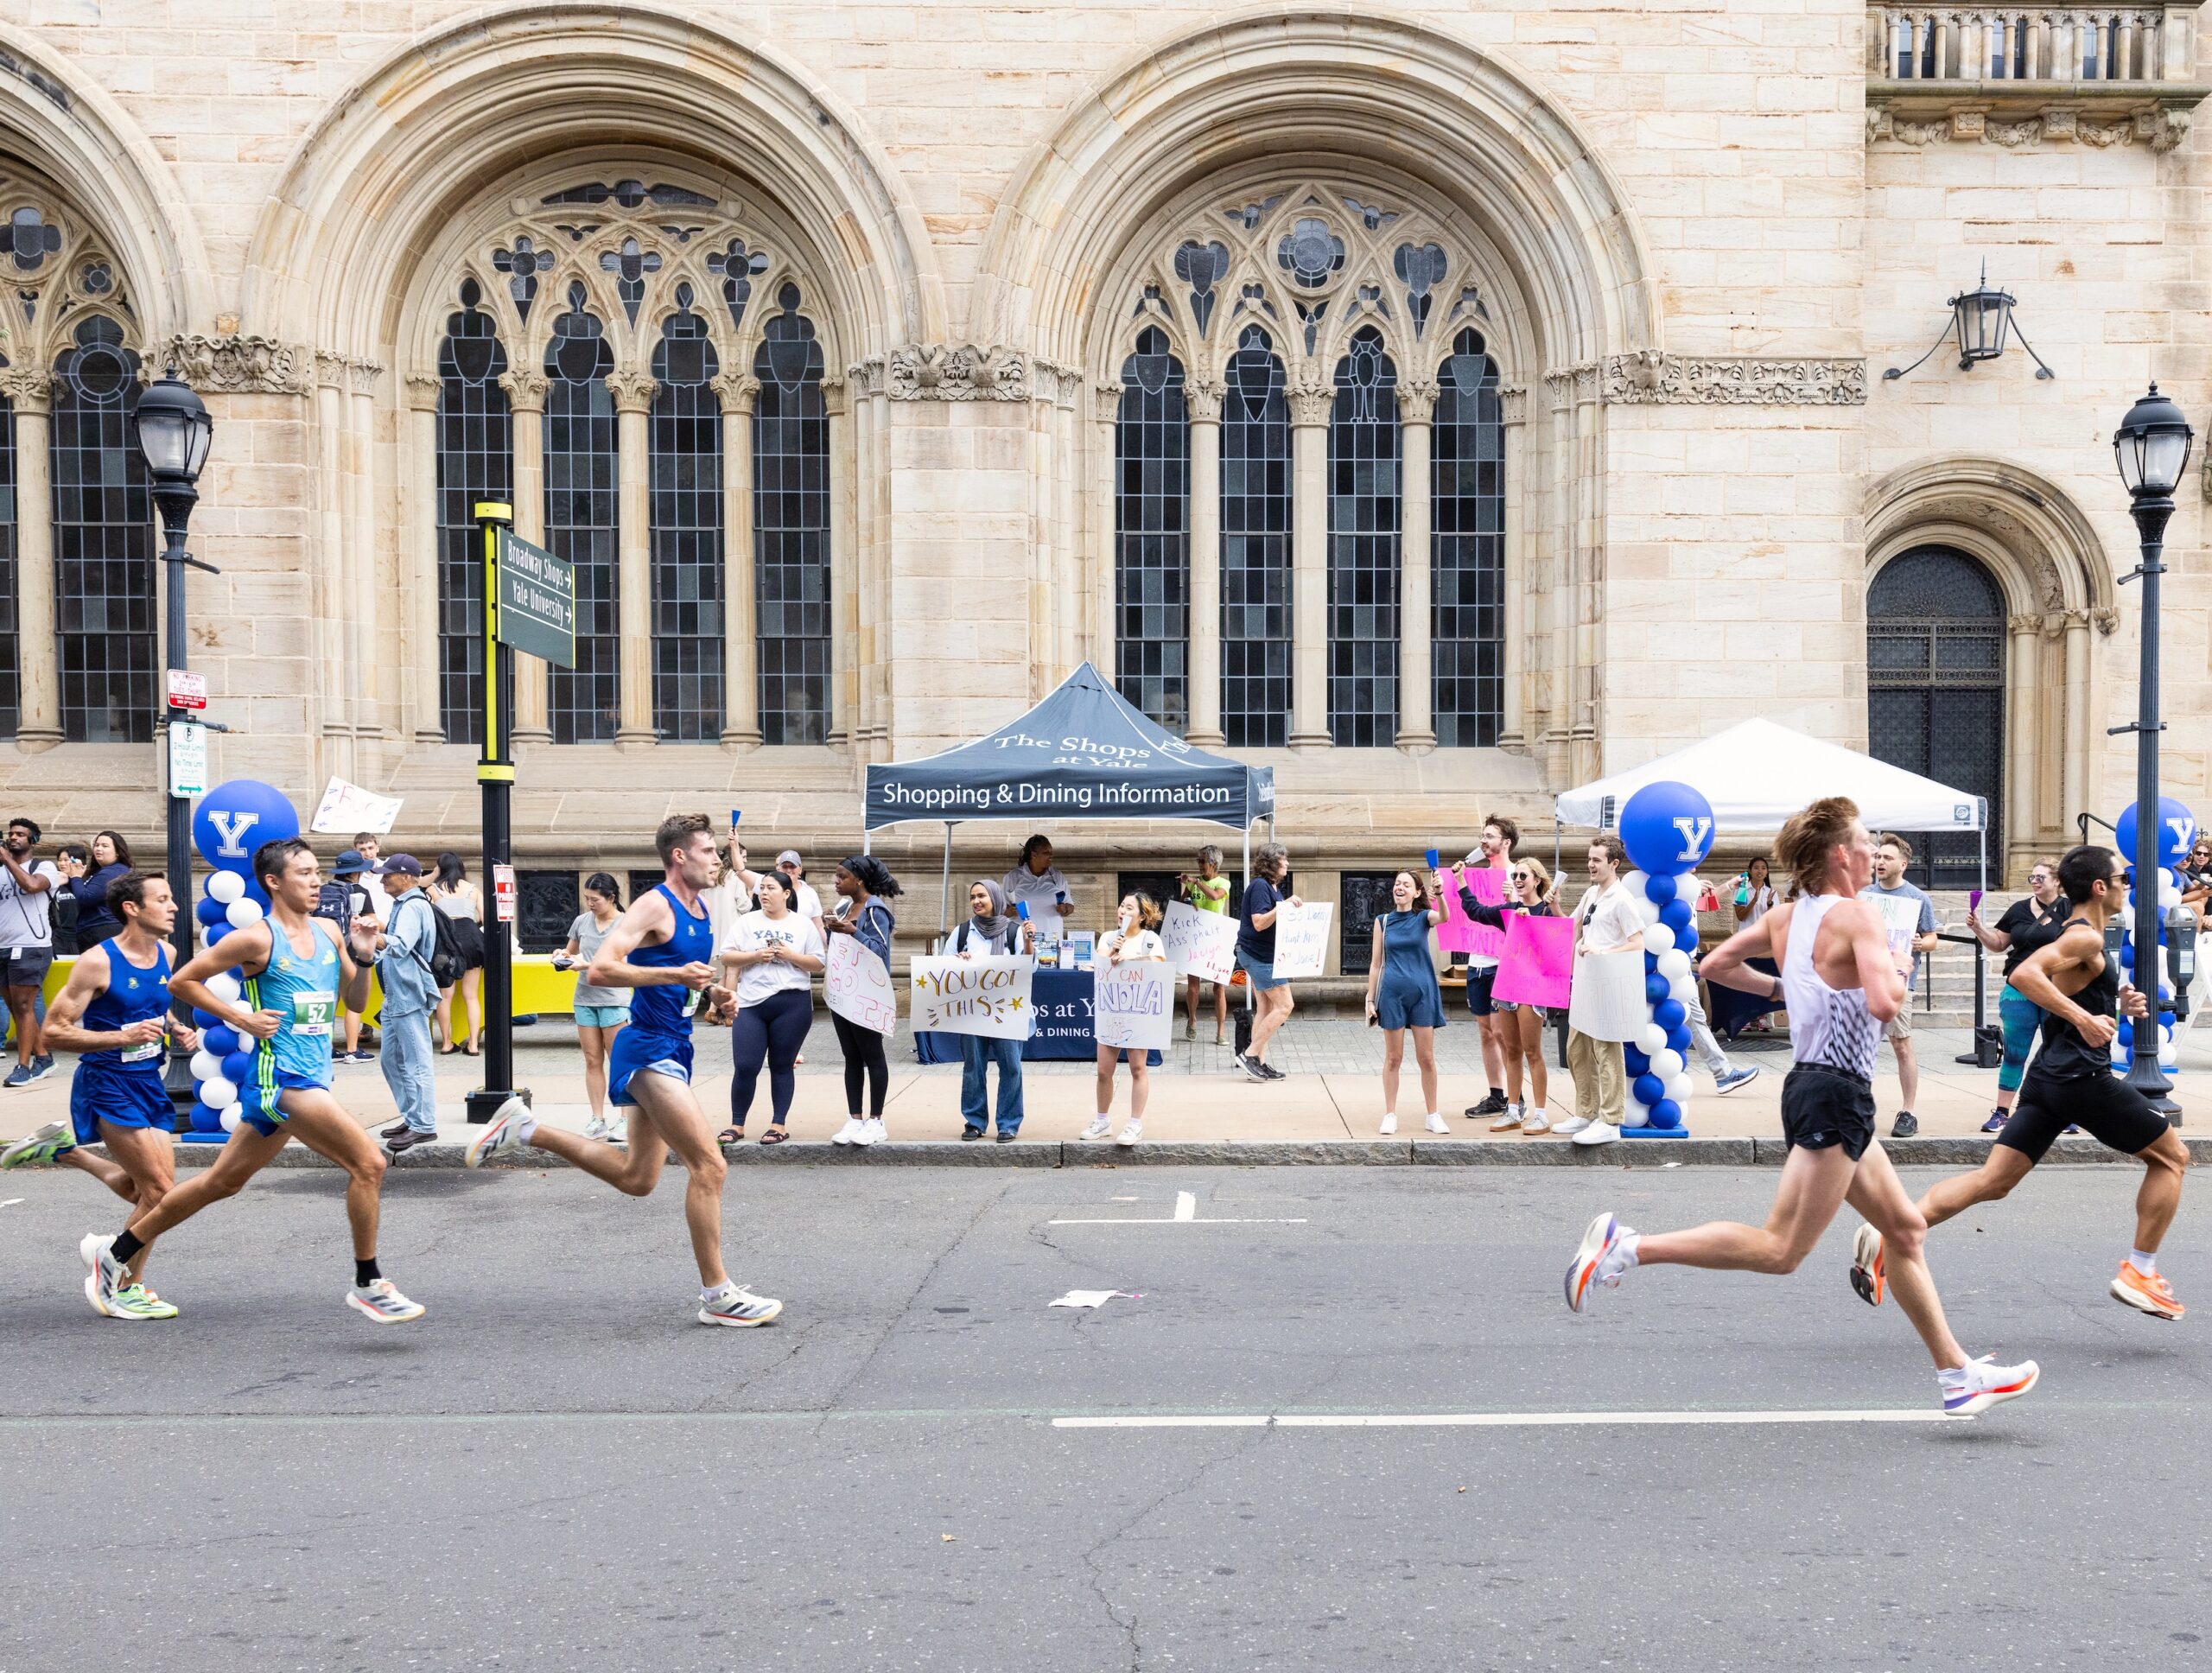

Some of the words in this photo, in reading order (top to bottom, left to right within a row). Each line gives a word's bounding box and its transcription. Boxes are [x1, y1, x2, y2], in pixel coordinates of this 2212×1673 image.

[508, 540, 543, 581] Broadway
[544, 558, 563, 589] Shops
[513, 580, 528, 606] Yale
[531, 588, 563, 626] University
[181, 674, 202, 683] PARKING
[994, 734, 1052, 749] The
[1059, 736, 1151, 760] Shops
[1052, 755, 1082, 765] at
[1087, 756, 1148, 768] Yale
[883, 782, 990, 809] Shopping
[996, 783, 1014, 804] &
[1019, 783, 1092, 809] Dining
[1098, 782, 1230, 804] Information
[208, 810, 259, 858] Y
[1673, 817, 1712, 862] Y
[2165, 817, 2195, 854] Y
[753, 930, 794, 944] YALE
[927, 969, 977, 996] YOU
[979, 969, 1020, 990] GOT
[1120, 967, 1143, 983] CAN
[308, 1003, 327, 1024] 52
[938, 996, 992, 1017] THIS
[1055, 1002, 1077, 1017] at
[1036, 1027, 1045, 1037] &
[1047, 1027, 1090, 1037] DINING
